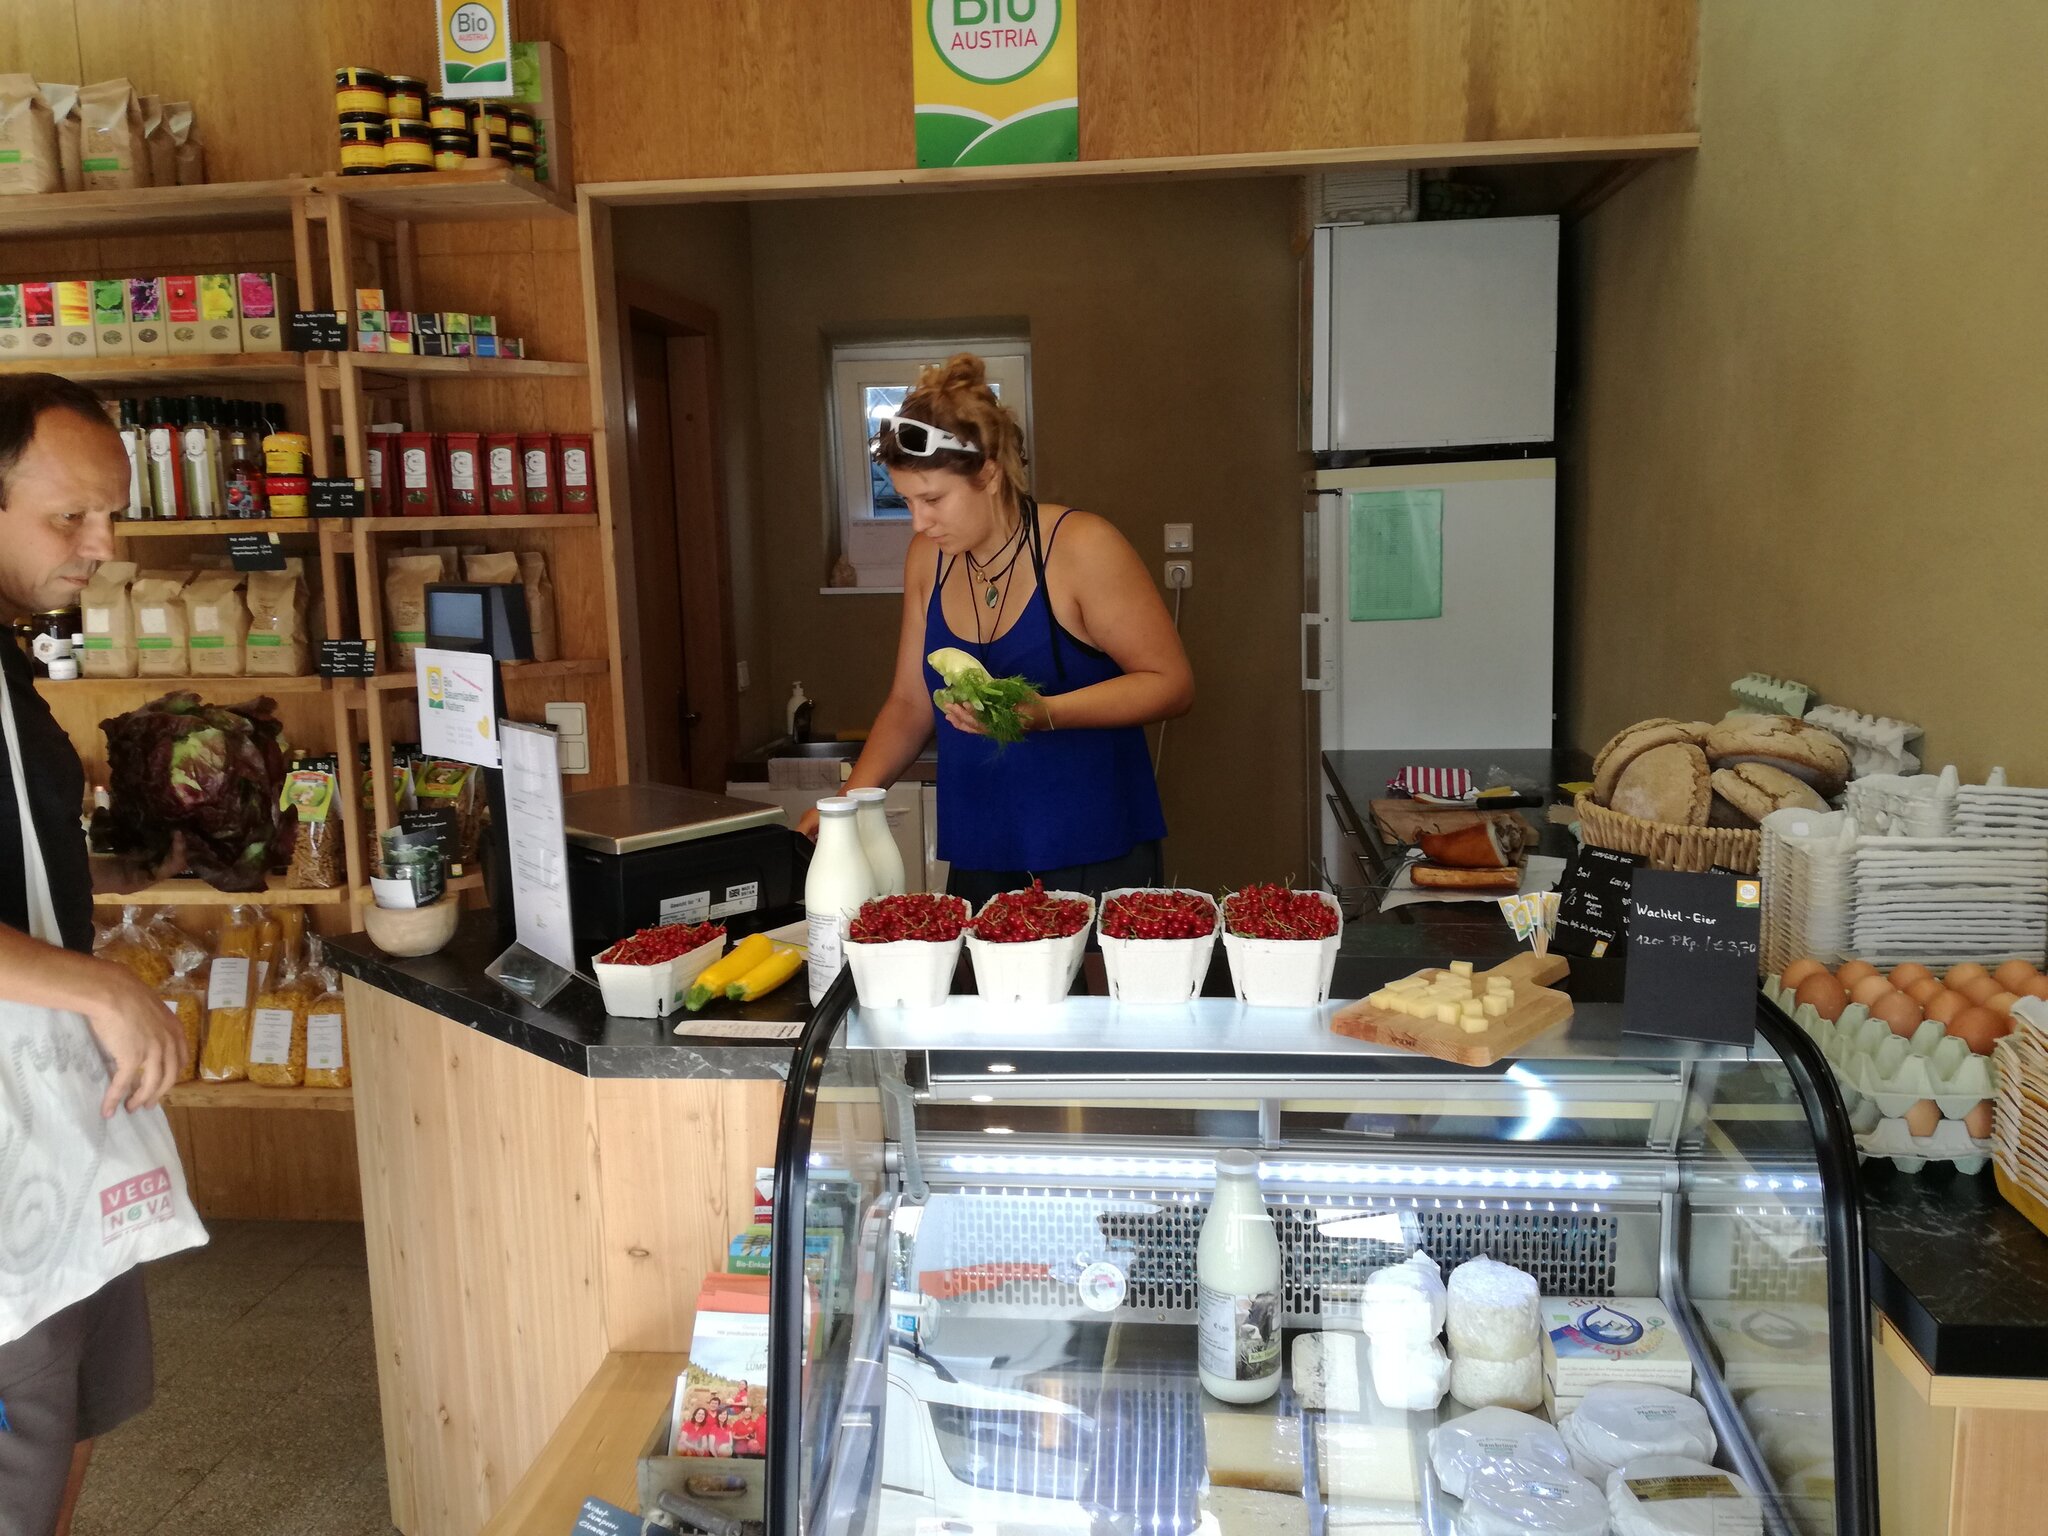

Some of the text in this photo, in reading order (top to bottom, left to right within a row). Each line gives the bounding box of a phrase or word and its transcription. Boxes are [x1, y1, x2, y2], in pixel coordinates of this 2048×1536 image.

[457, 12, 488, 33] Bio
[951, 28, 1039, 51] AUSTRIA
[107, 1173, 169, 1208] VEGA
